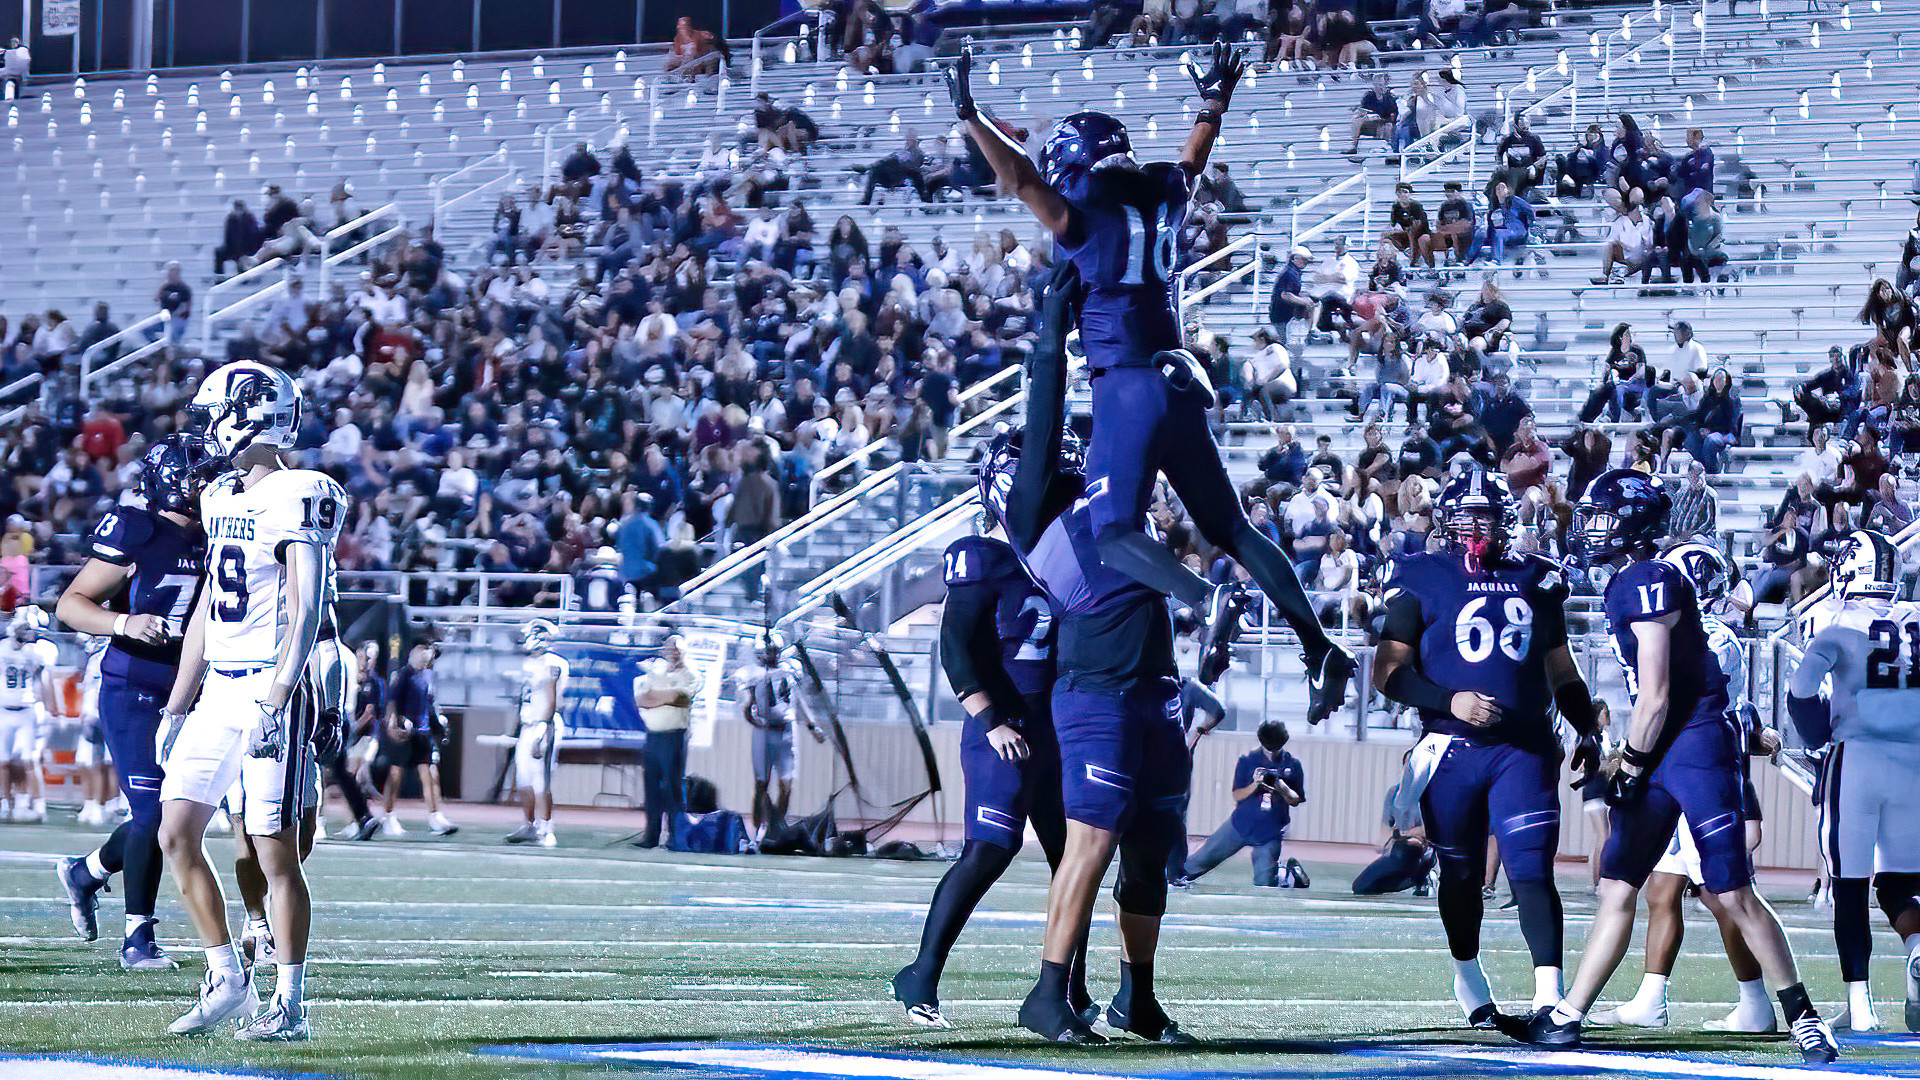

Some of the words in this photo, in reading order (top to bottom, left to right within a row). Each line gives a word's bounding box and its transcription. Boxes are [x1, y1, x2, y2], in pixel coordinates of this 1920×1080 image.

[301, 497, 337, 529] 19
[945, 550, 967, 582] 24
[1466, 582, 1519, 593] JAGUARS
[1636, 581, 1665, 614] 17
[1013, 595, 1052, 660] 2
[1455, 596, 1534, 664] 68
